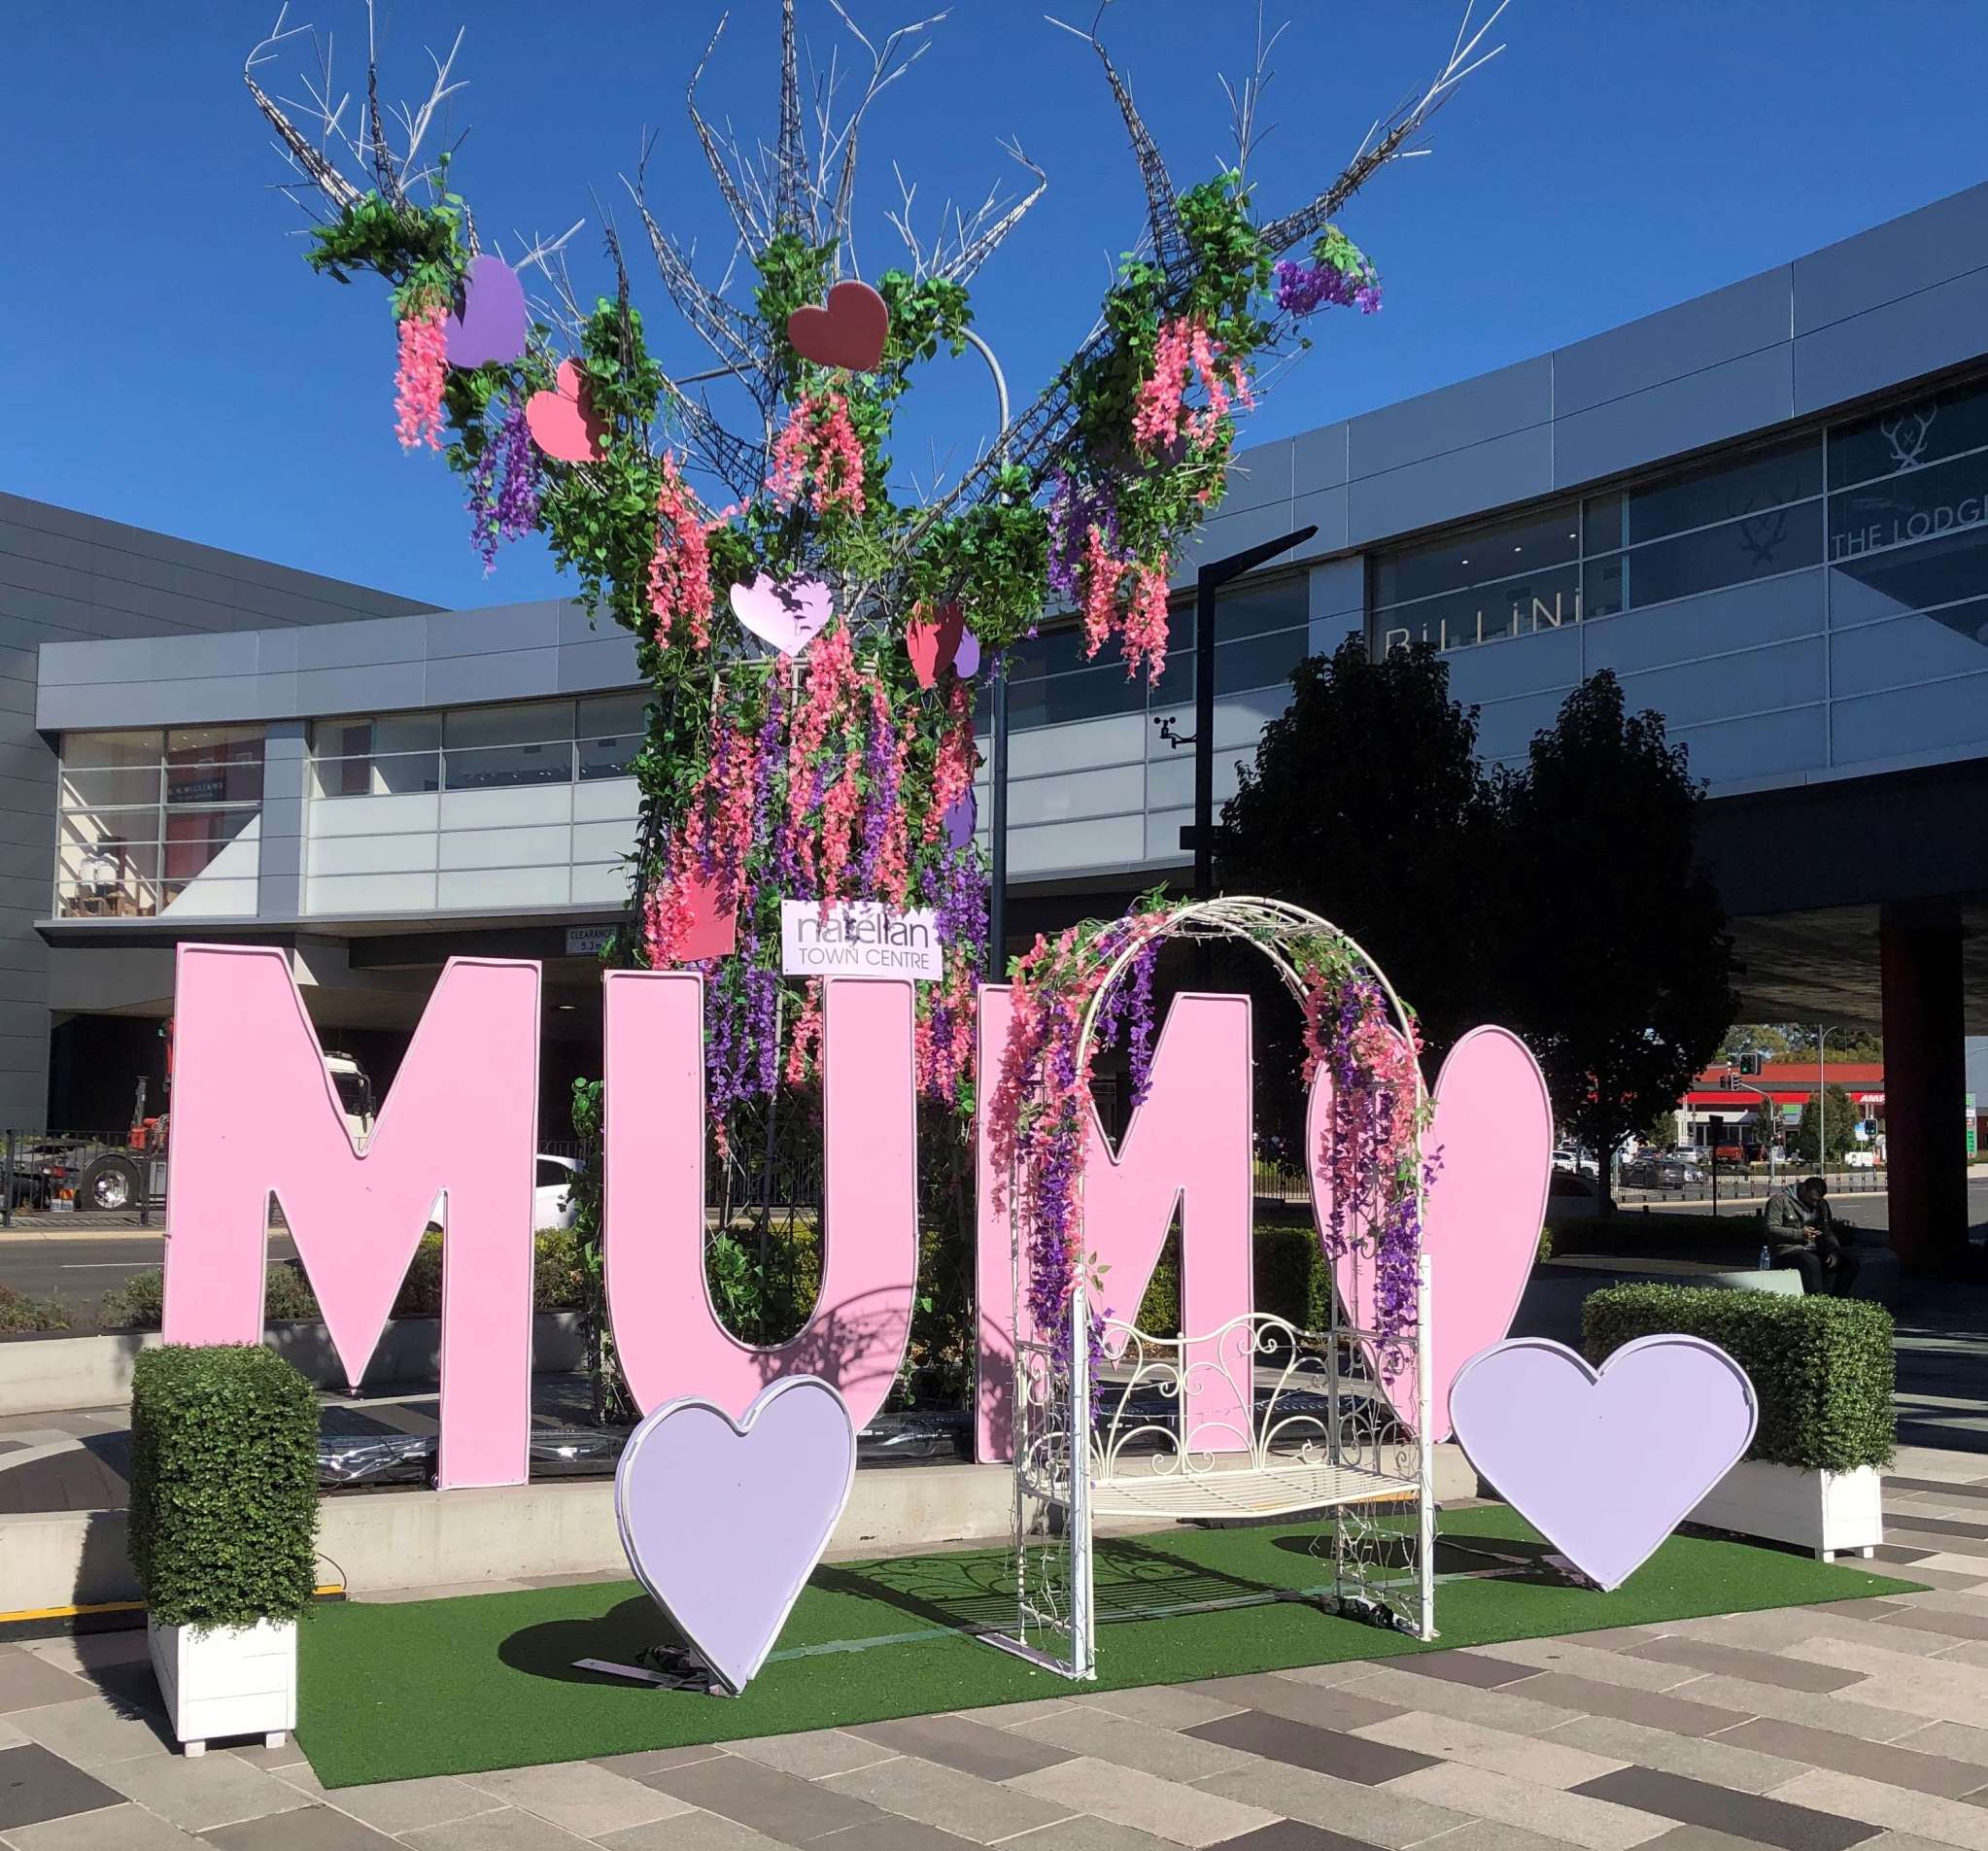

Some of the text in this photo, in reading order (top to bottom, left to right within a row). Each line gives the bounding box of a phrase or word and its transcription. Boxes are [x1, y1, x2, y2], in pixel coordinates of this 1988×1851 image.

[1831, 524, 1882, 560] THE
[799, 947, 930, 970] TOWN CENTRE
[161, 942, 1254, 1491] MUM
